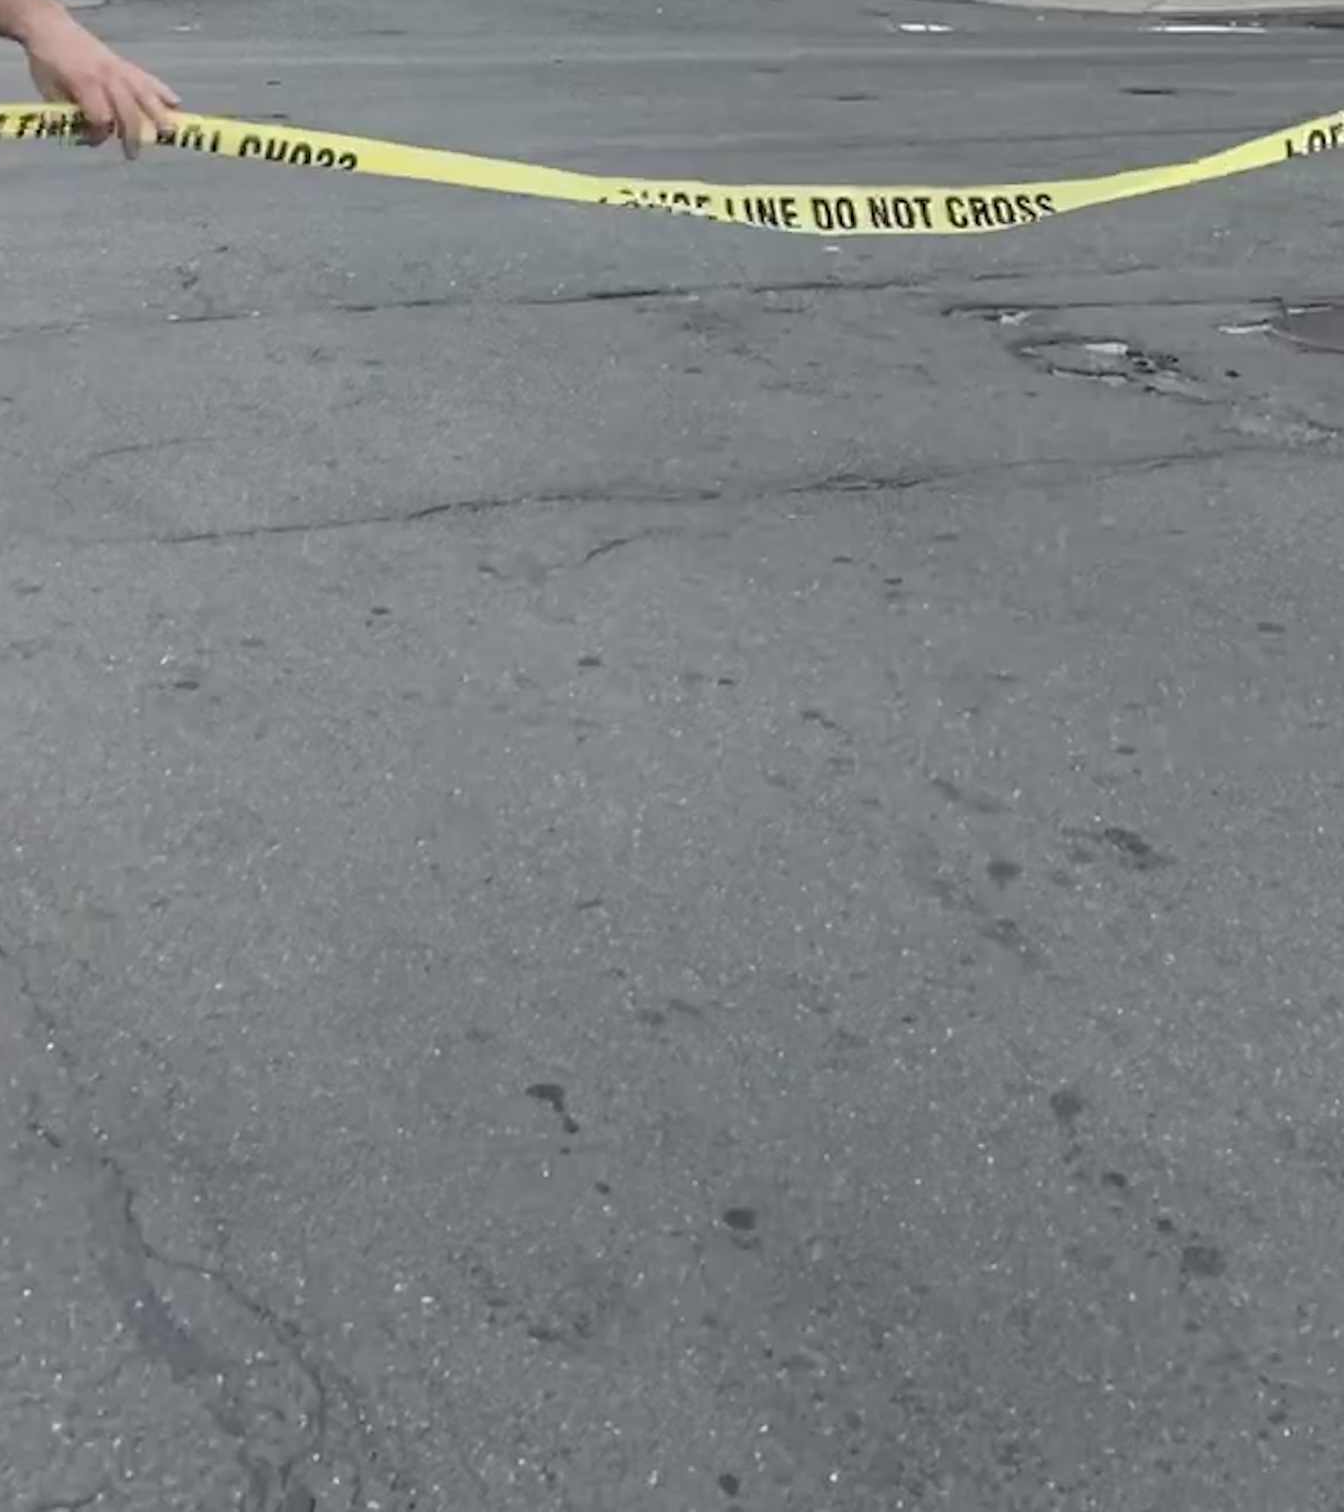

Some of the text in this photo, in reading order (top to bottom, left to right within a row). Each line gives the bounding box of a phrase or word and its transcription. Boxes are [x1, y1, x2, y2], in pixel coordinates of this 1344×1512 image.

[812, 198, 857, 231] DO
[870, 196, 935, 230] NOT
[947, 193, 1058, 229] CROSS
